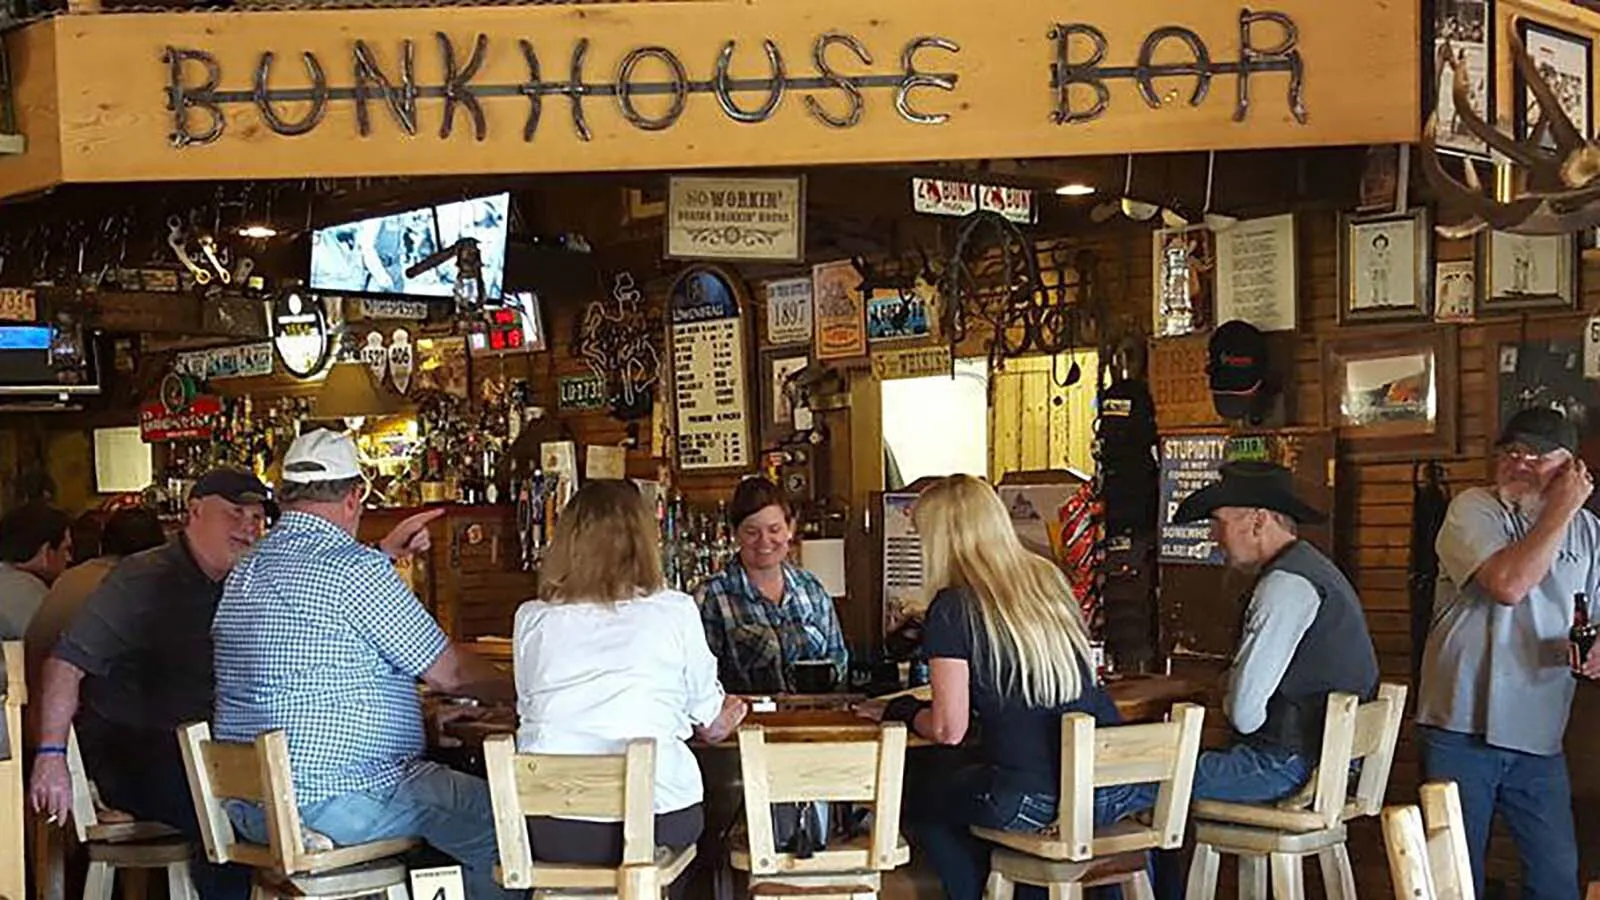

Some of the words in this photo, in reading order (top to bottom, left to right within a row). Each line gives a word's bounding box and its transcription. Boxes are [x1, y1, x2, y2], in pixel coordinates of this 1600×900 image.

[162, 29, 961, 149] BUNKHOUSE
[1046, 7, 1307, 126] BAR
[686, 189, 708, 207] NO
[709, 189, 784, 209] WORKIN'
[772, 298, 808, 327] 1897
[1164, 439, 1225, 460] STUPIDITY
